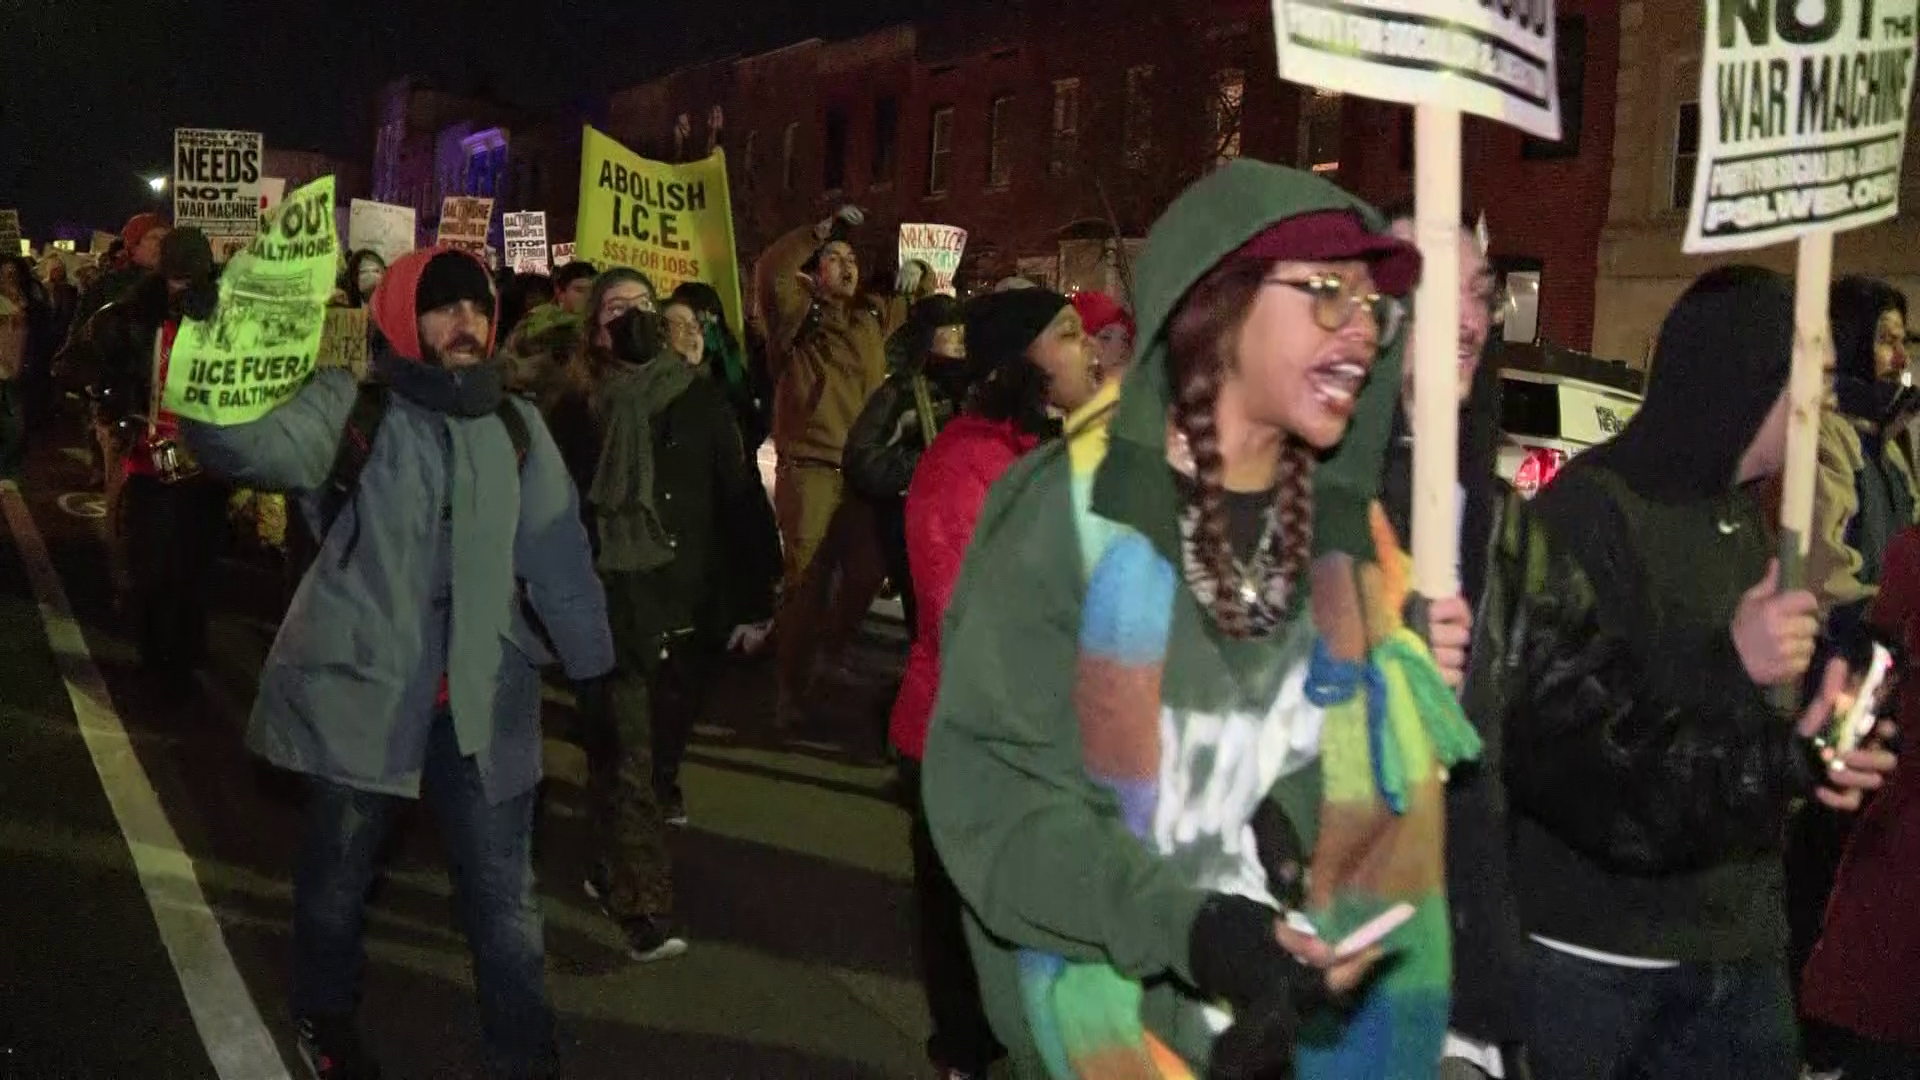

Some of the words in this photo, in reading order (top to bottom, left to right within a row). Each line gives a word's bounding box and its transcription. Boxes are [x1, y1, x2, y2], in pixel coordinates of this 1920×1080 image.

[1718, 58, 1789, 144] WAR
[1796, 46, 1912, 135] MACHINE
[178, 147, 259, 184] NEEDS
[177, 186, 238, 200] NOT
[599, 159, 706, 211] ABOLISH
[177, 201, 205, 217] WAR
[207, 202, 258, 219] MACHINE
[281, 192, 329, 239] OUT
[613, 196, 690, 251] I.C.E.
[631, 247, 659, 270] FOR
[184, 386, 211, 405] DE
